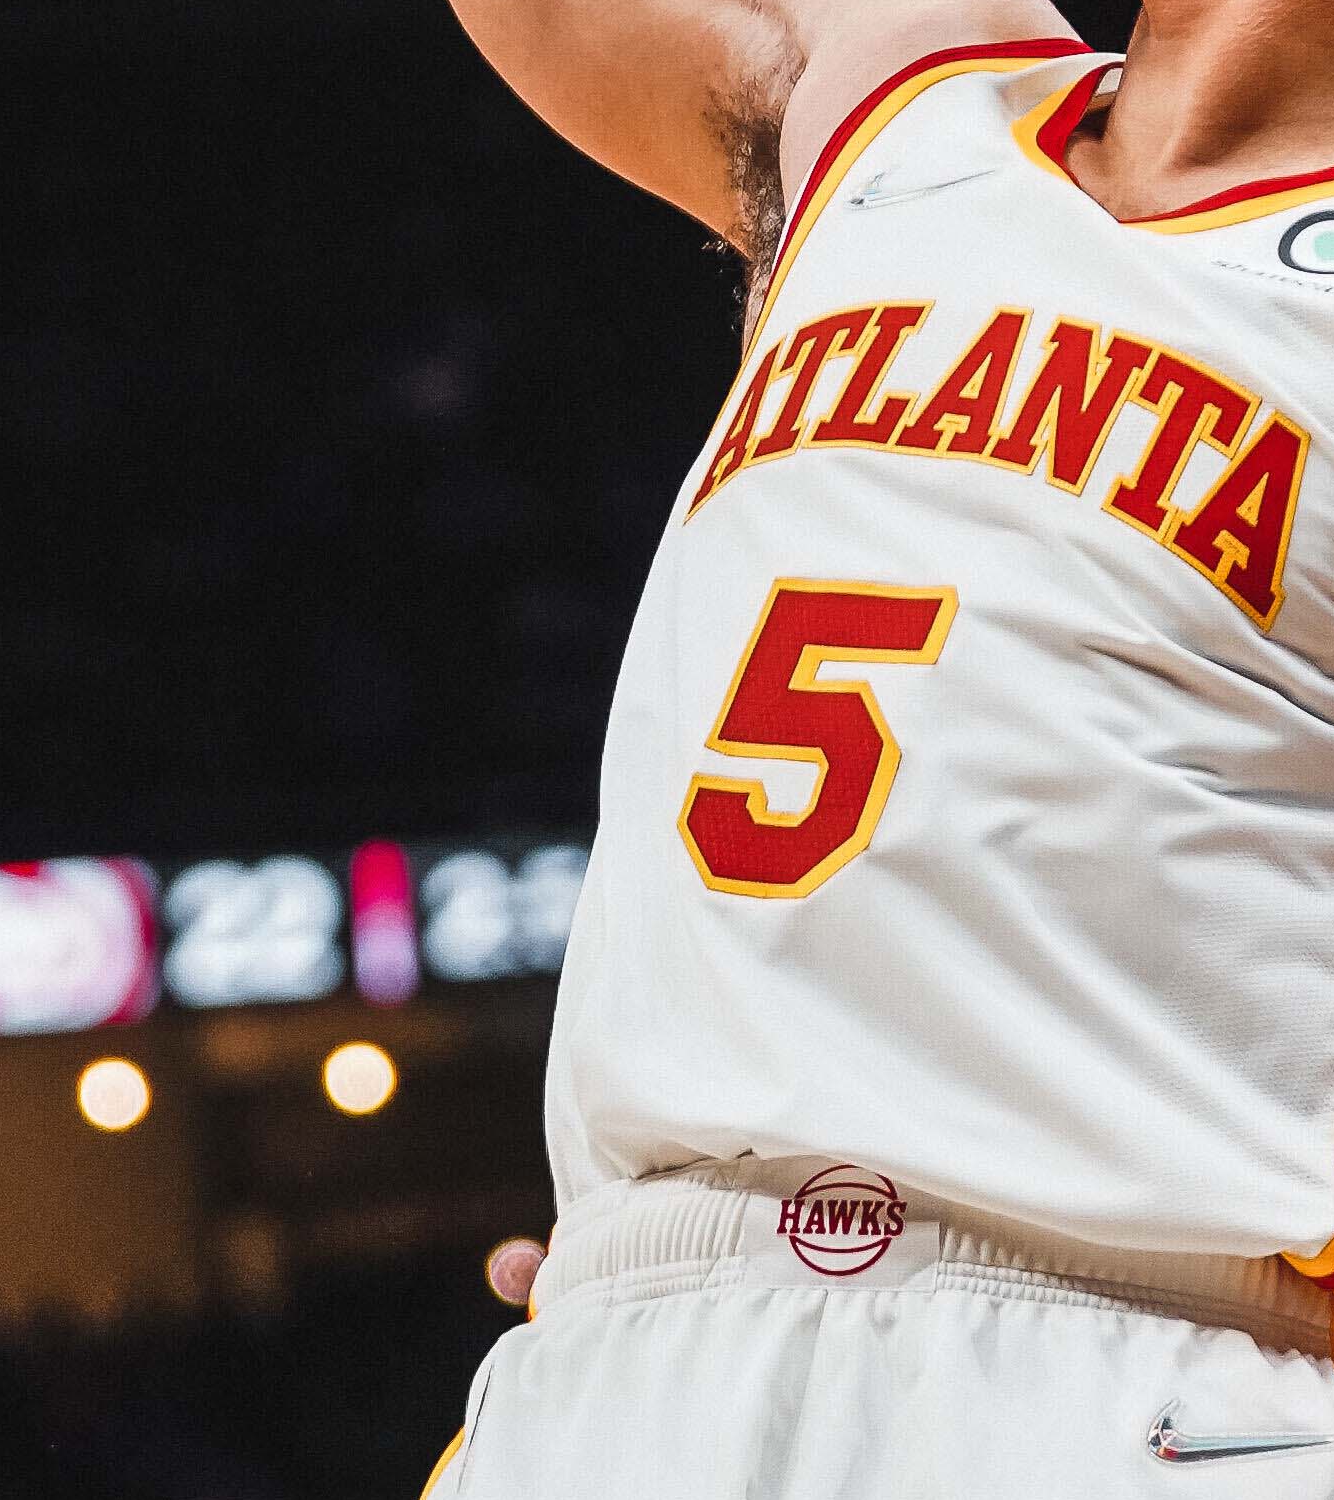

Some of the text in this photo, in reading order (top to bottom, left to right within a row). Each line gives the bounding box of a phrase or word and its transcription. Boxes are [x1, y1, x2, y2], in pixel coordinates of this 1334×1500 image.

[683, 299, 1311, 633] ATLANTA
[678, 577, 959, 899] 5
[776, 1199, 908, 1237] HAWKS
